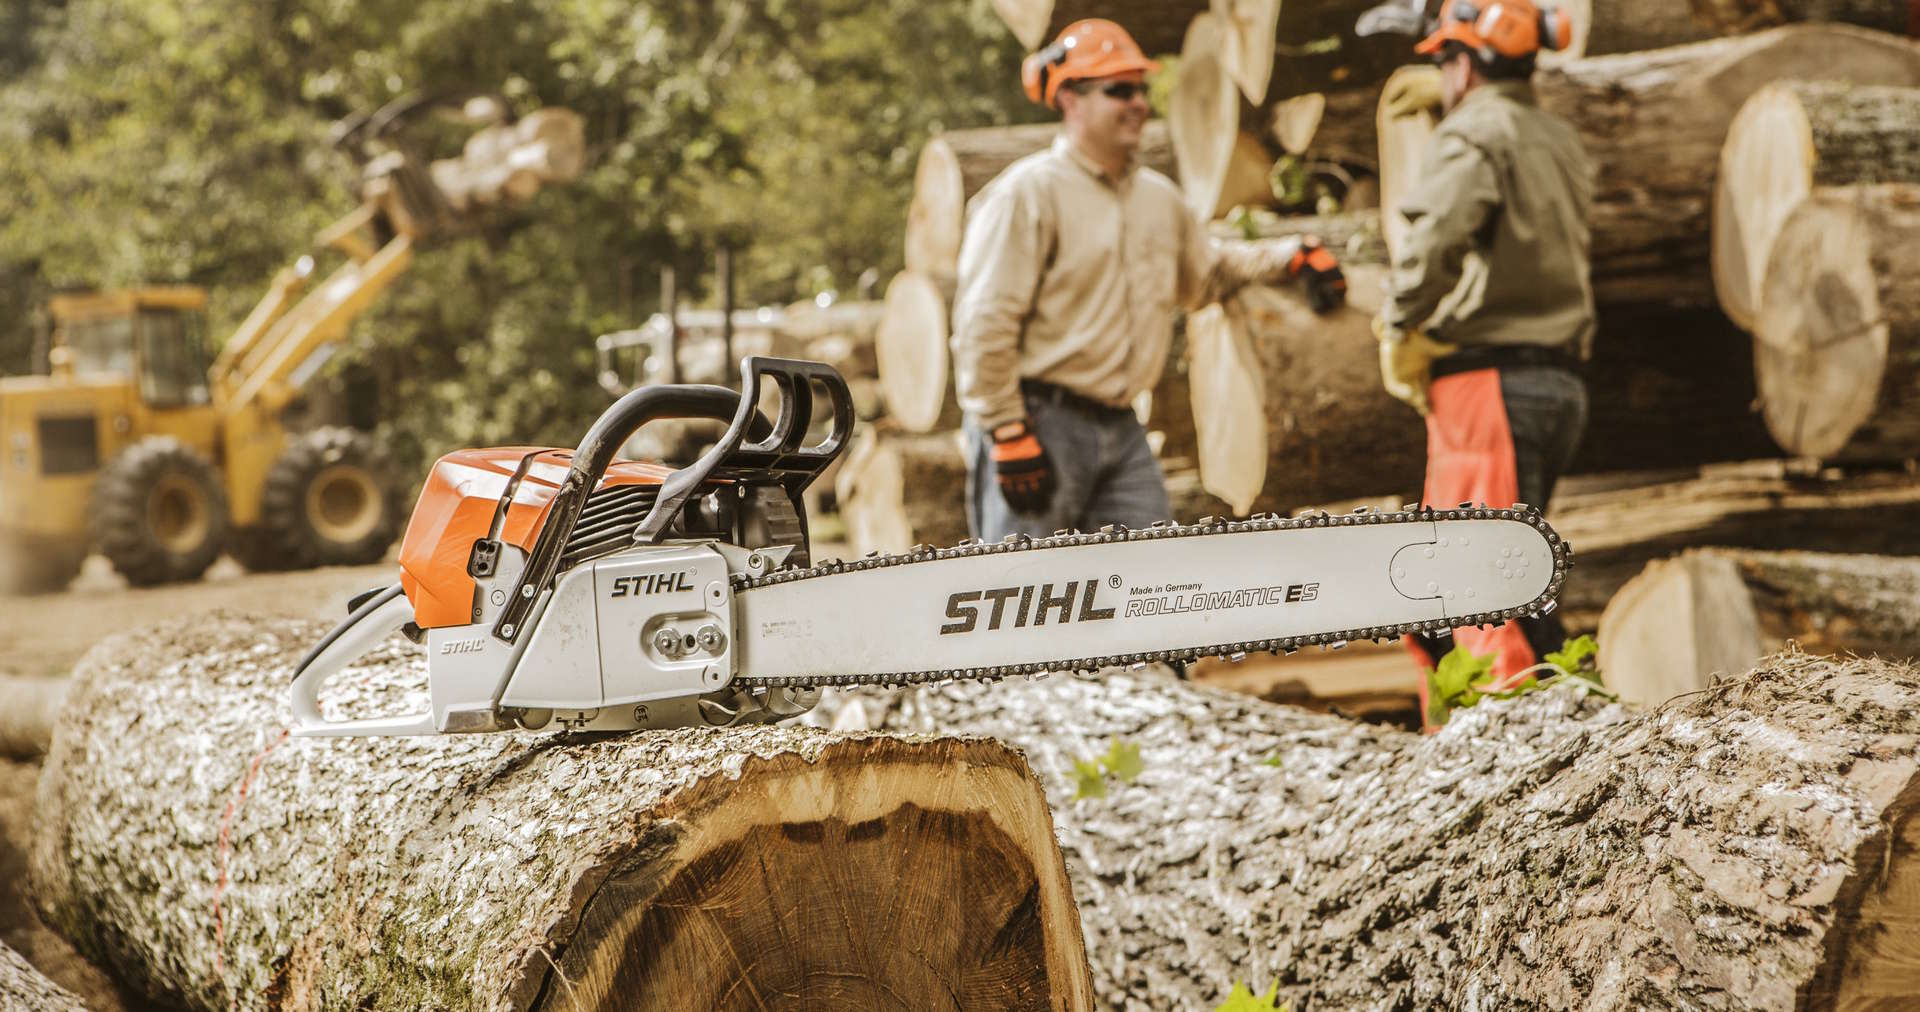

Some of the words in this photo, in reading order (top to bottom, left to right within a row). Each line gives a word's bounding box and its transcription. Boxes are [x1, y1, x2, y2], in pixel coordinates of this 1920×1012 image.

[611, 572, 694, 598] STIHL
[1130, 586, 1153, 596] Made
[1154, 585, 1163, 593] in
[1165, 583, 1203, 592] Germany
[940, 579, 1116, 635] STIHL
[1125, 586, 1282, 617] ROLLOMATIC
[1285, 582, 1320, 603] ES
[440, 639, 485, 655] STIHL
